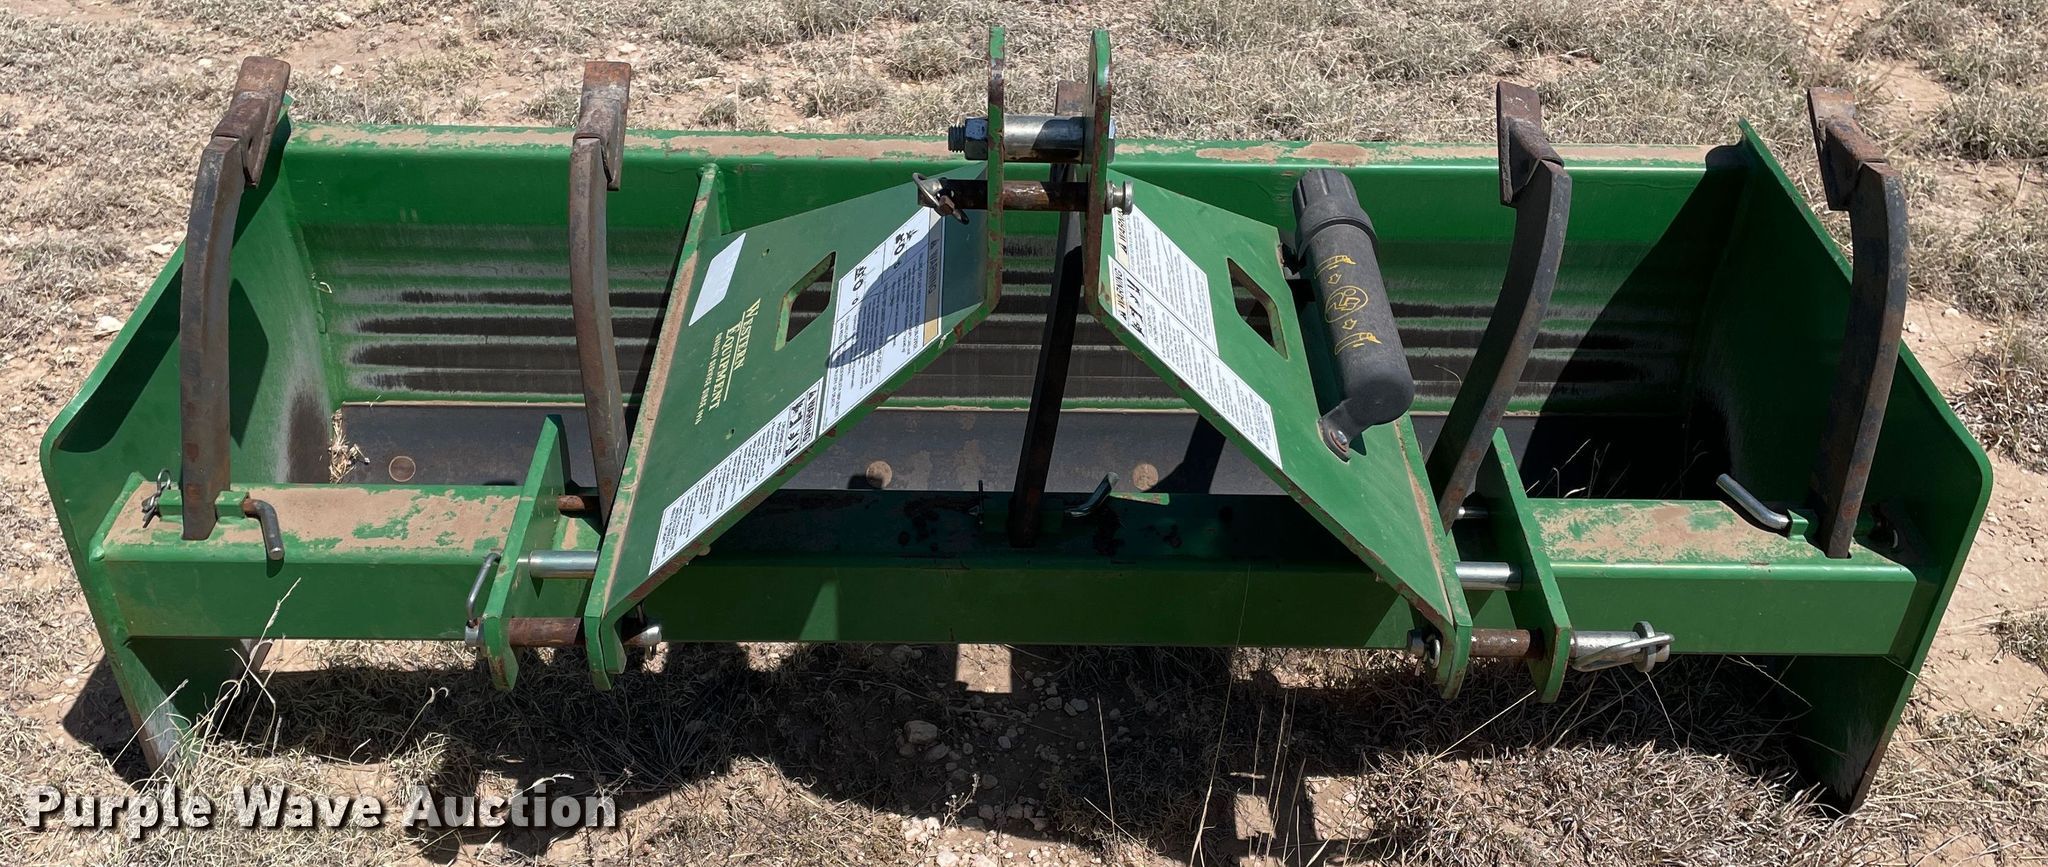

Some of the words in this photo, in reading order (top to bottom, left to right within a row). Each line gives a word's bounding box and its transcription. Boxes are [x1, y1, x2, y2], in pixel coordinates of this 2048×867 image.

[928, 248, 938, 295] WARNING
[1114, 267, 1126, 310] WARNING
[734, 298, 761, 370] WESTERN
[709, 321, 742, 411] EQUIPMENT
[802, 397, 816, 443] WARNING
